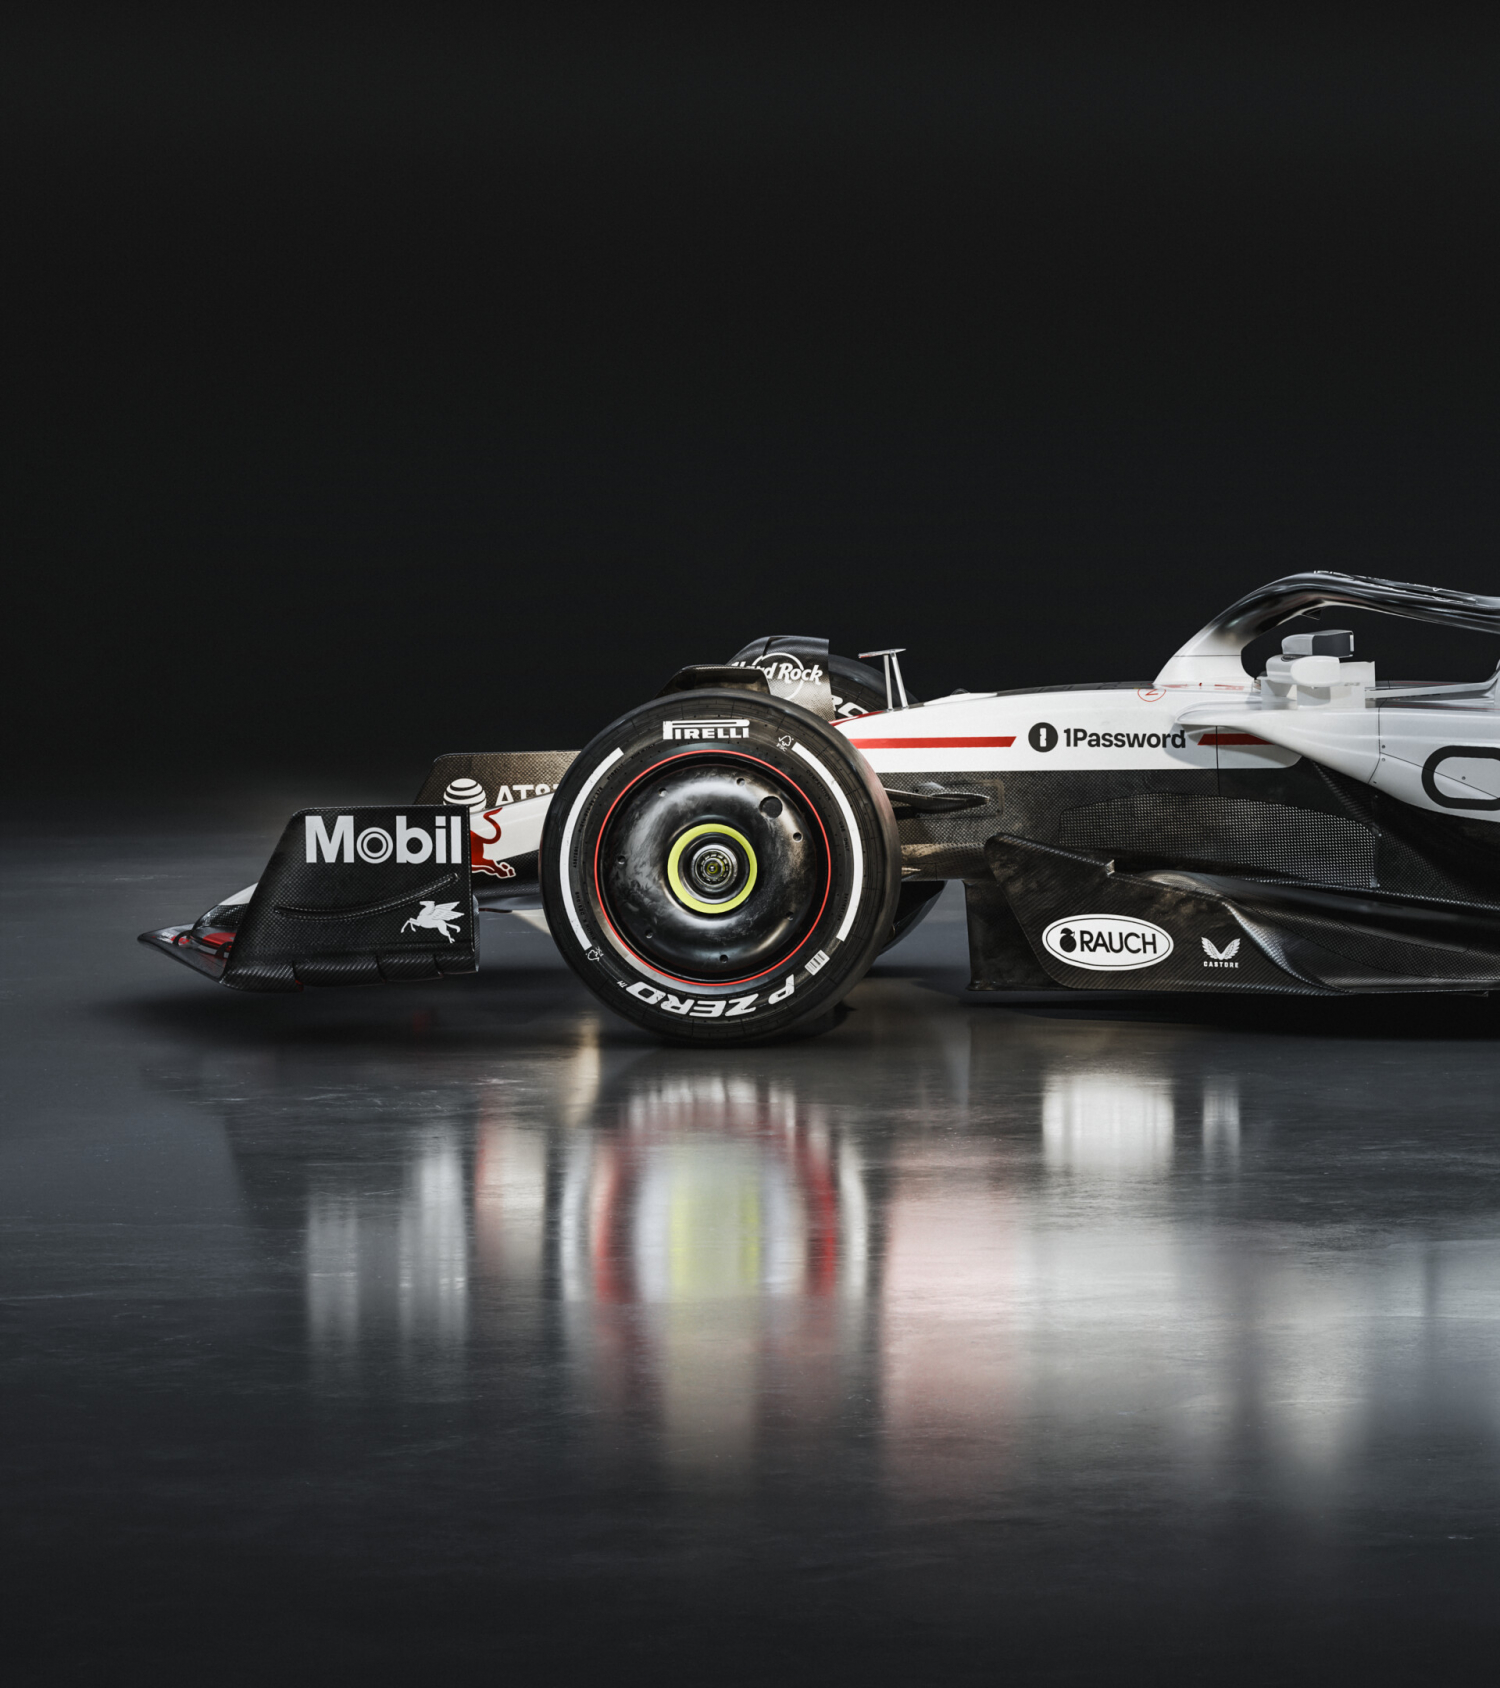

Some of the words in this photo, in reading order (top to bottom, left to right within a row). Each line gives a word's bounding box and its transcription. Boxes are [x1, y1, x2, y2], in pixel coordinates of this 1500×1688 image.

[778, 662, 823, 685] Rock
[663, 719, 750, 740] PIRELLI
[1064, 728, 1186, 749] 1Password
[495, 783, 559, 806] AT
[305, 815, 462, 864] Mobil
[1080, 930, 1158, 954] RAUCH
[626, 981, 759, 1018] ZERO
[768, 974, 795, 1005] P
